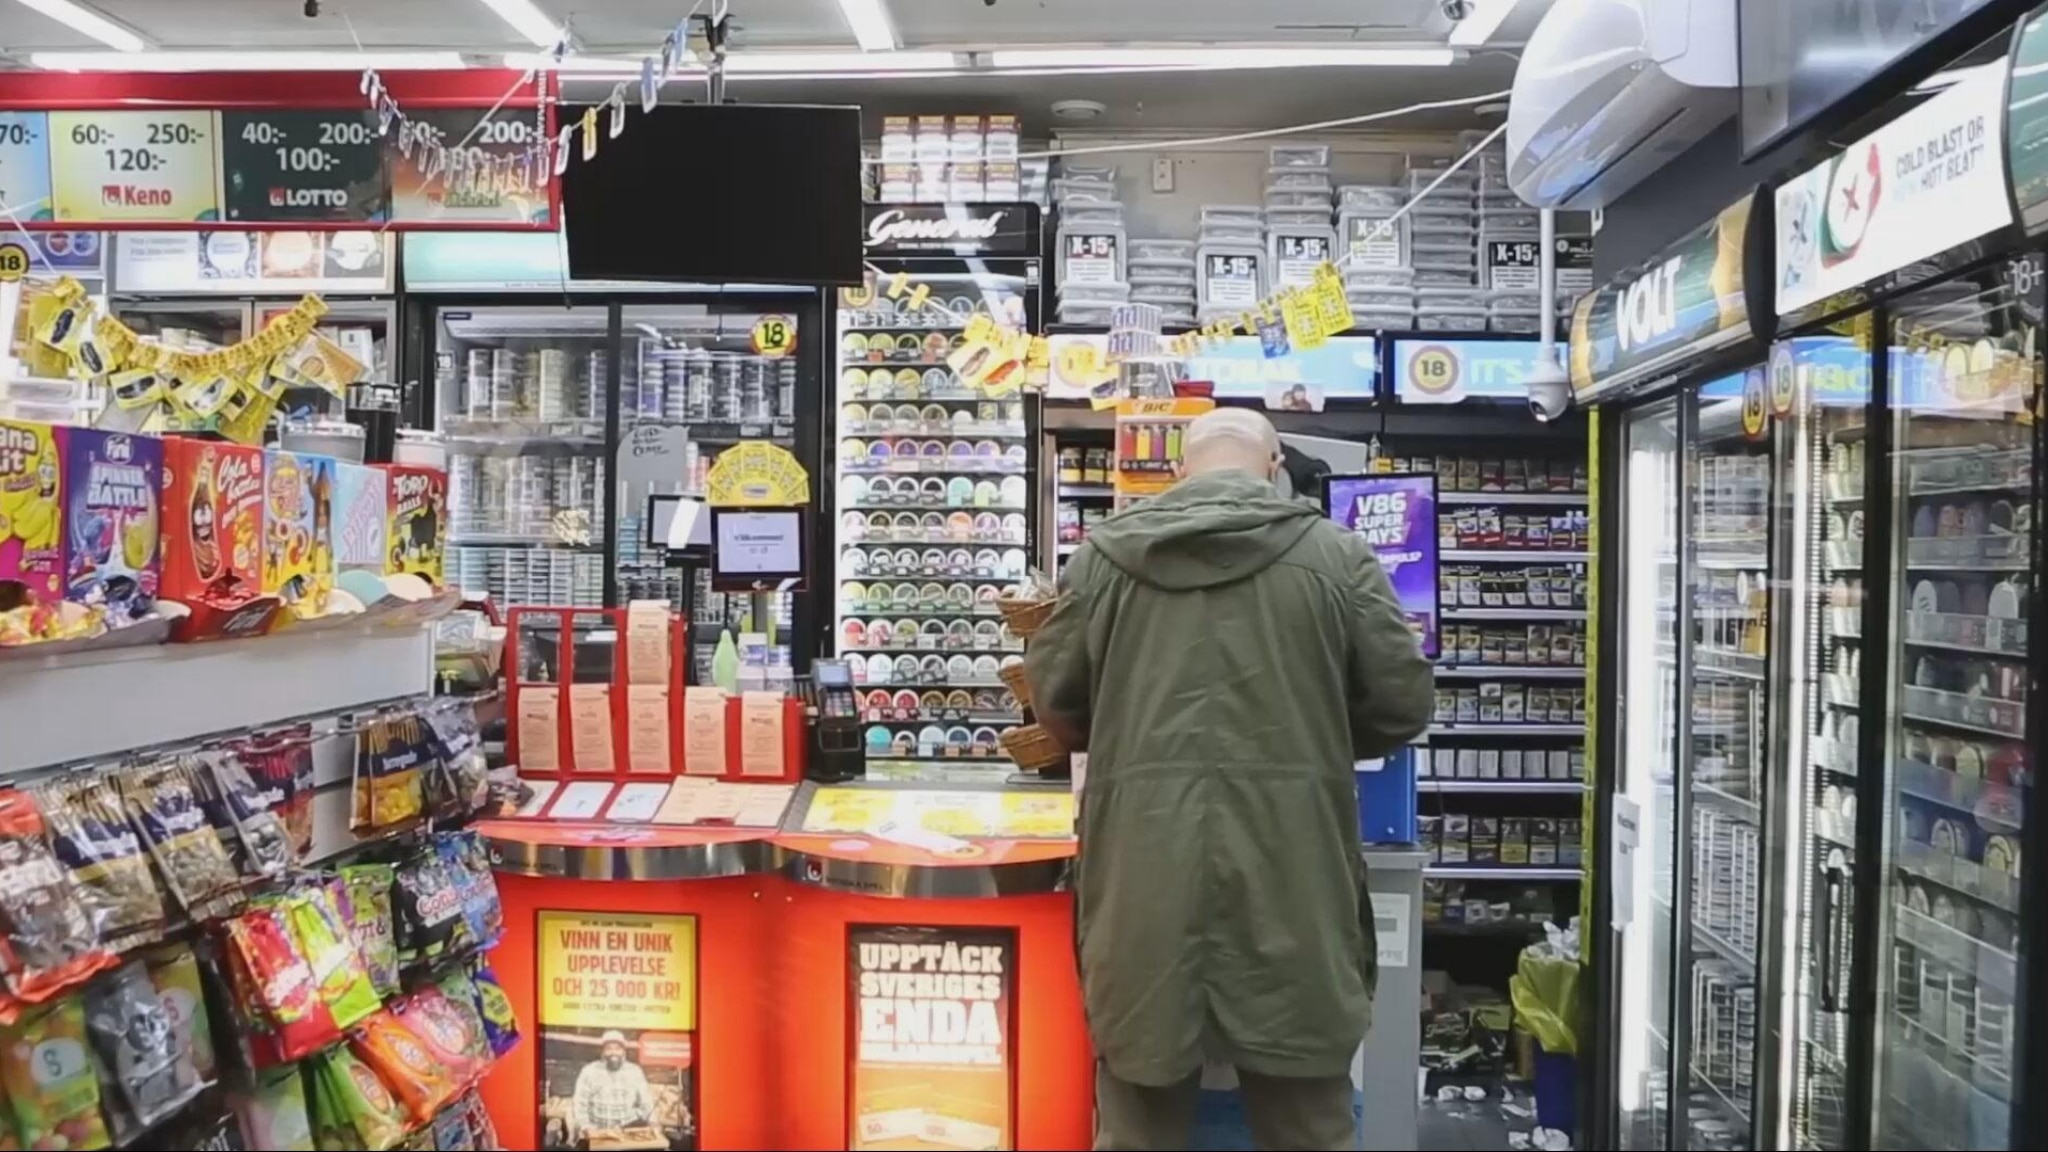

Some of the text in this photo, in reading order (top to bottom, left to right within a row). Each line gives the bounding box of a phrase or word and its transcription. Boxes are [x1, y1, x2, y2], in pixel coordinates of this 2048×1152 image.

[72, 124, 115, 145] 60:-
[147, 123, 205, 144] 250:-
[242, 122, 287, 145] 40:-
[319, 122, 379, 145] 200:-
[1896, 116, 1984, 178] COLD BLAST OR
[105, 149, 167, 171] 120:-
[276, 148, 341, 171] 100:-
[125, 186, 172, 206] Keno
[286, 188, 348, 206] LOTTO
[863, 209, 1004, 246] General
[1072, 236, 1109, 254] X-15
[1285, 238, 1320, 255] X-15
[1497, 243, 1533, 261] X-15
[0, 255, 21, 270] 18
[1214, 258, 1249, 273] X-15
[2008, 260, 2044, 295] 18+
[1616, 255, 1681, 351] VOLT
[763, 323, 784, 347] 18
[1420, 360, 1447, 377] 18
[1142, 402, 1171, 413] BIC
[392, 474, 429, 498] TORO
[1357, 491, 1407, 516] V86
[1354, 513, 1404, 530] SUPER
[560, 930, 673, 953] VINN EN UNIK
[567, 954, 666, 976] UPPLEVELSE
[859, 941, 1003, 973] UPPTÄCK
[552, 977, 681, 1001] OCH 25 000 KR!
[860, 972, 1001, 1000] SVERIGES
[860, 997, 1002, 1045] ENDA
